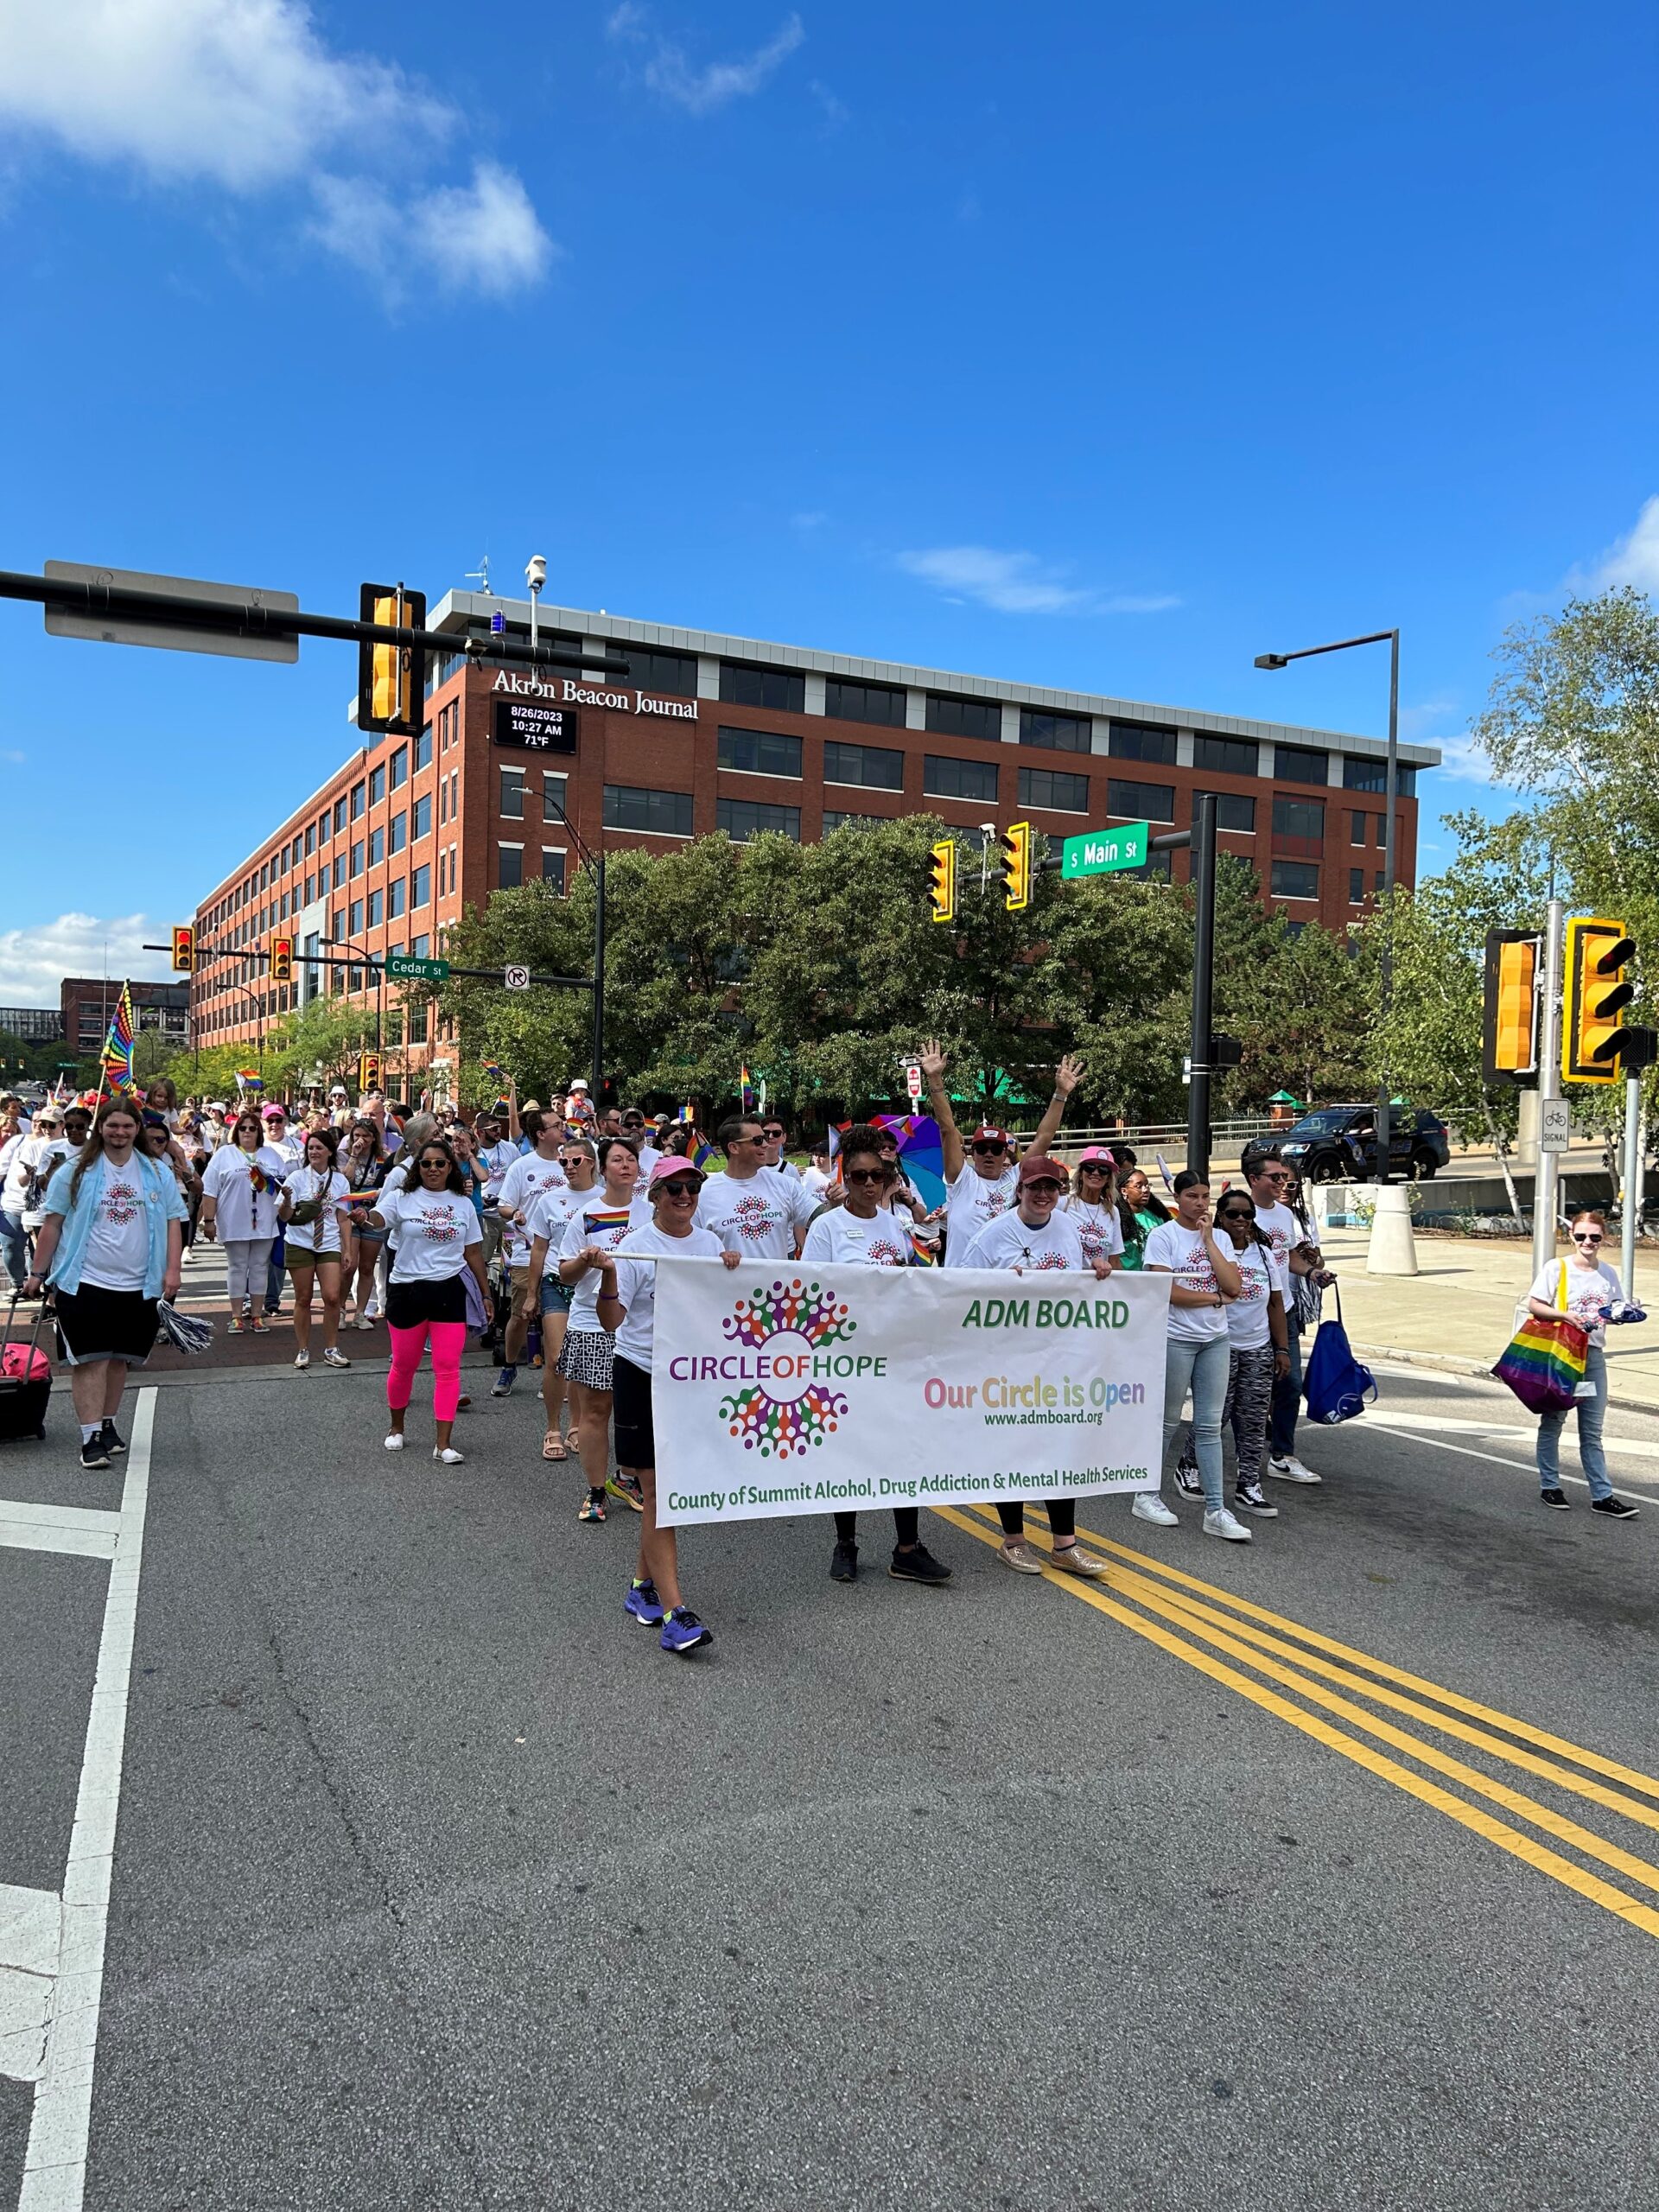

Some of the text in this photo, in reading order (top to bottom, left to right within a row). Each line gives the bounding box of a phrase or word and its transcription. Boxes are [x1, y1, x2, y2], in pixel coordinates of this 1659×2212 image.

[493, 670, 699, 720] Akron Beacon Journal
[511, 706, 563, 722] 8/26/2023
[512, 720, 563, 735] 10:27 AM
[1084, 840, 1119, 866] Main
[1125, 841, 1138, 859] St
[391, 960, 442, 976] Cedar St
[1543, 1133, 1567, 1142] SIGNAL
[962, 1300, 1129, 1328] ADM BOARD
[925, 1375, 1145, 1413] Our Circle is Open
[984, 1409, 1103, 1426] www.admboard.org
[668, 1464, 1147, 1511] County of Summit Alcohol, Drug Addiction & Mental Health Services
